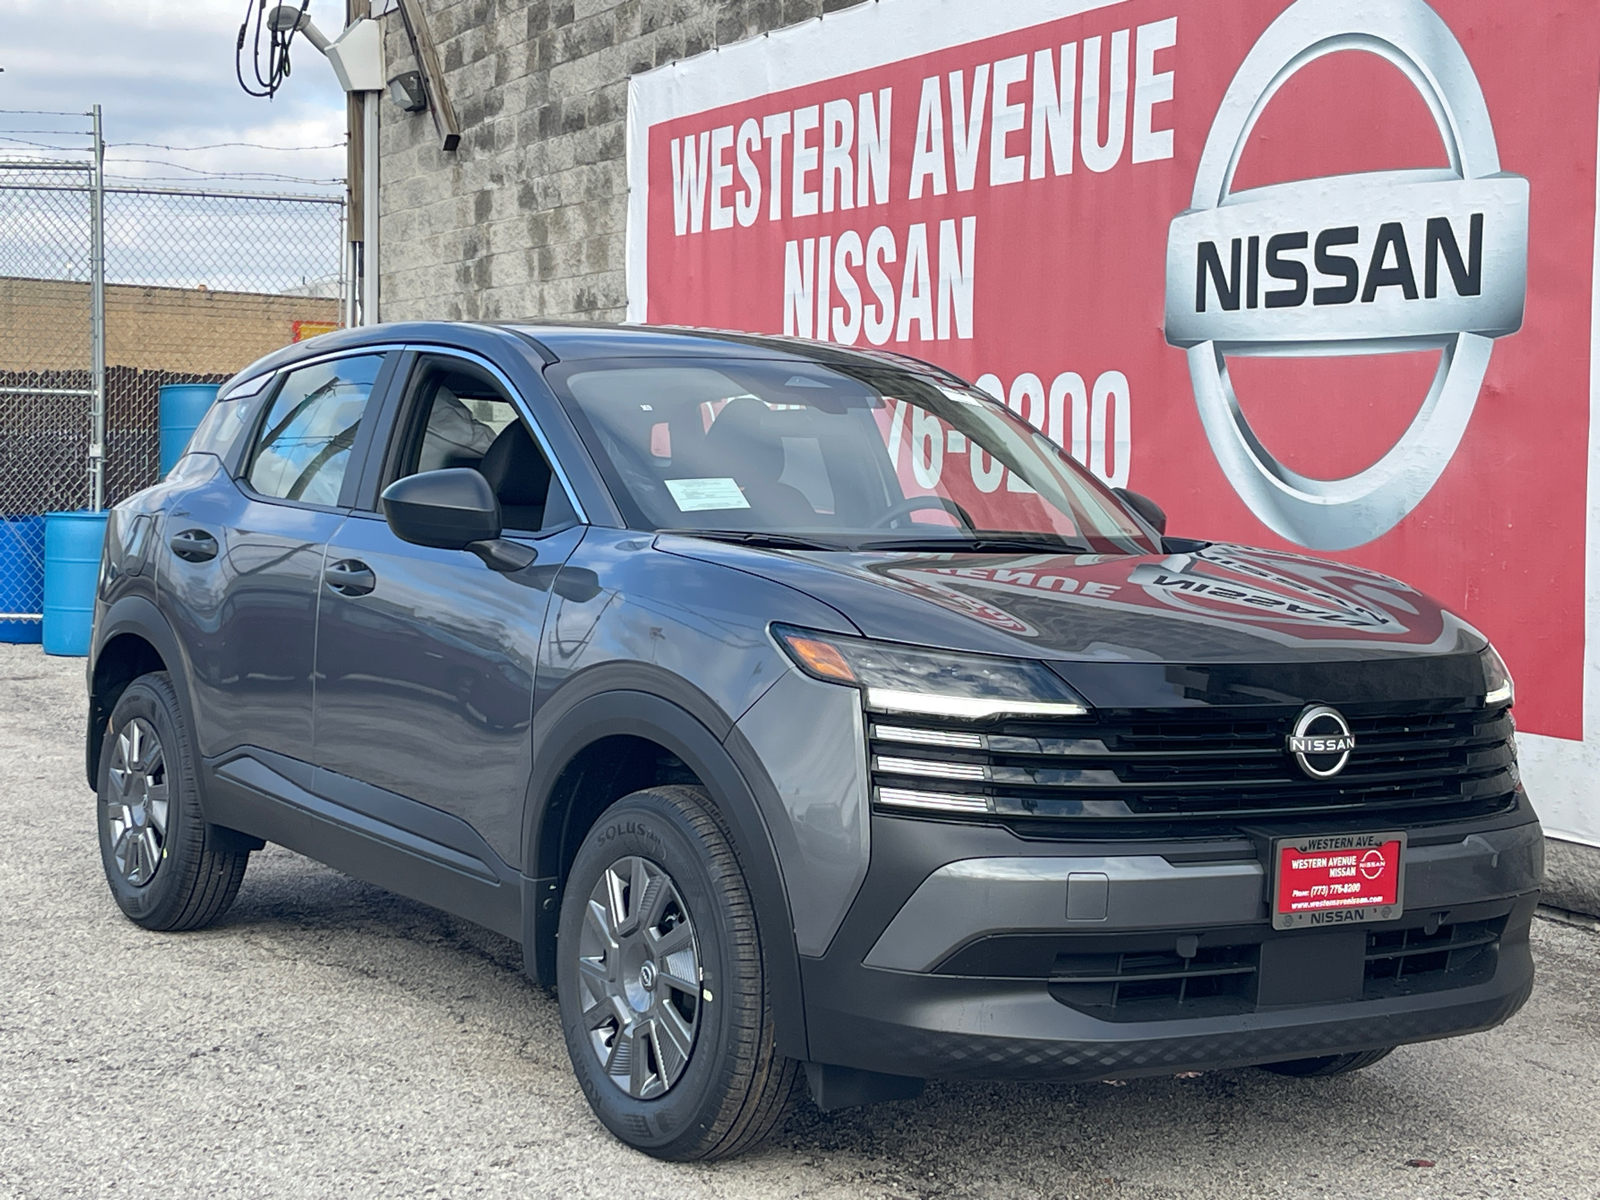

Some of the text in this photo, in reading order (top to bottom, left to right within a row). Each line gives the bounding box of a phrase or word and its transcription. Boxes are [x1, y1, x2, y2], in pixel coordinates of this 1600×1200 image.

[671, 17, 1177, 236] WESTERN AVENUE
[1196, 213, 1483, 313] NISSAN
[784, 216, 977, 346] NISSAN
[1292, 738, 1355, 751] NISSAN
[597, 822, 646, 847] SOLUS
[1308, 839, 1354, 850] WESTERN
[1291, 856, 1357, 869] WESTERN AVENUE
[1329, 867, 1356, 878] NISSAN
[1310, 886, 1328, 898] (773)
[1310, 909, 1364, 924] NISSAN
